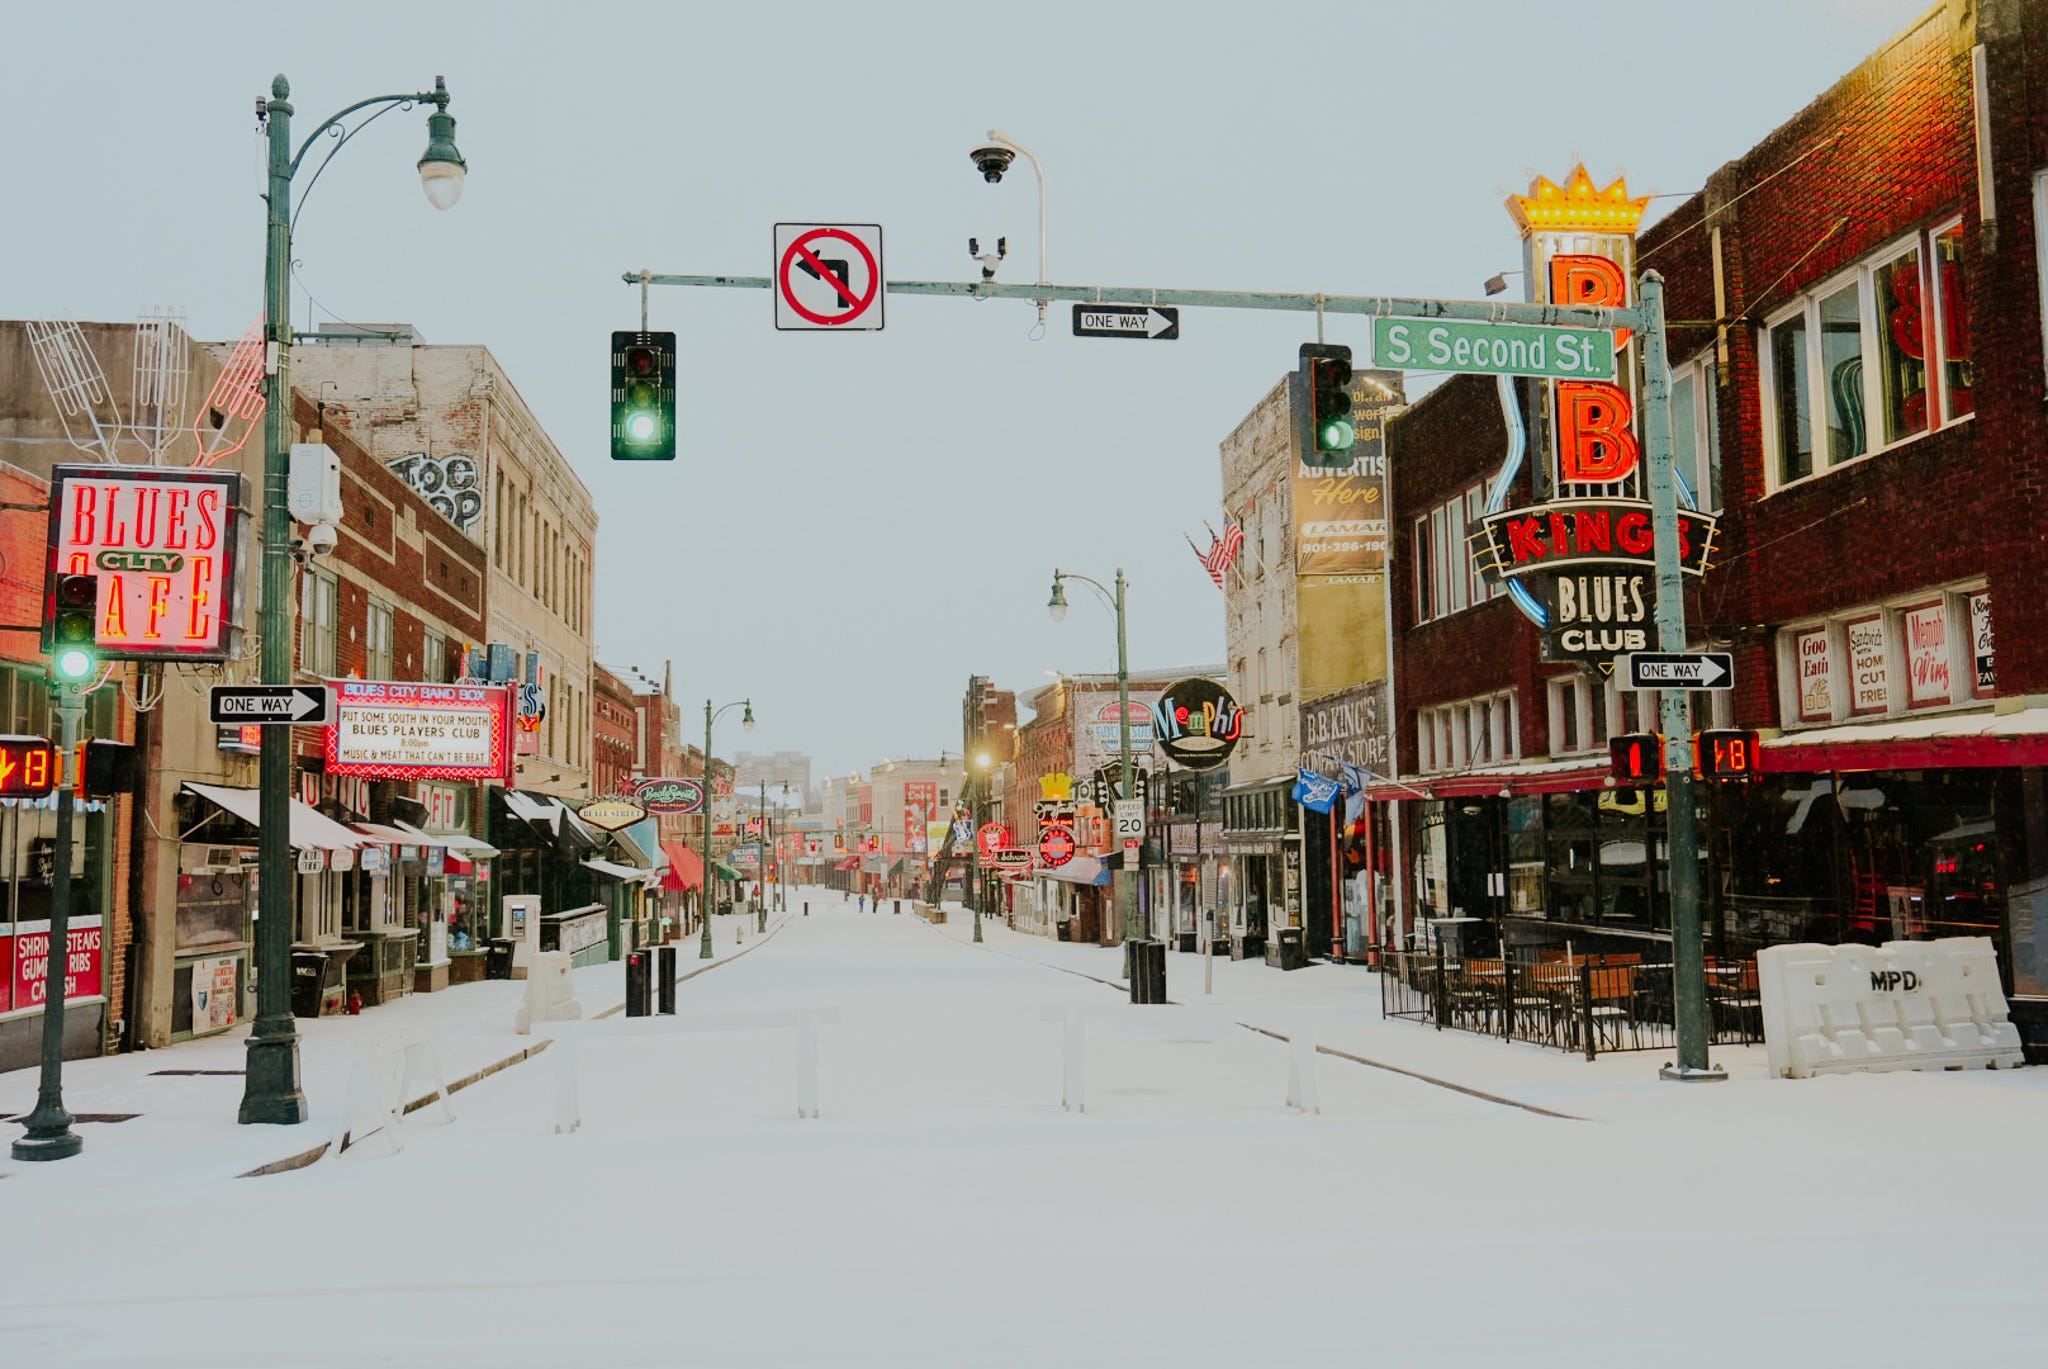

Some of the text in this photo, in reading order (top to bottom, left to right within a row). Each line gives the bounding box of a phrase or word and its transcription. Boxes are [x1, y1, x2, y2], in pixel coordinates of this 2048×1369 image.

[1085, 314, 1148, 329] ONE WAY
[1387, 325, 1602, 374] S. Second St.
[1558, 380, 1640, 485] B
[1311, 474, 1380, 505] Here
[68, 485, 218, 550] BLUES
[101, 552, 182, 571] CITY
[1328, 575, 1377, 584] LAMAR
[68, 552, 213, 640] AFE
[1558, 575, 1646, 624] BLUES
[1560, 629, 1647, 652] CLUB
[1641, 664, 1700, 678] ONE WAY
[1860, 670, 1886, 685] CUT
[344, 683, 486, 700] BLUES CITY BAND BOX
[223, 698, 293, 712] ONE WAY
[342, 711, 489, 726] PUT SOME SOUTH IN YOUR MOUTH
[1152, 695, 1245, 741] Memphis
[352, 724, 480, 739] BLUES PLAYERS CLUB
[343, 749, 485, 763] MUSIC & MEAT THAT CAN'T BE BEAT
[1347, 734, 1388, 767] STORE
[25, 750, 47, 787] 13
[1118, 803, 1142, 811] SPEED
[1119, 819, 1142, 832] 20
[66, 931, 101, 953] STEAKS
[69, 952, 91, 974] RIBS
[1870, 970, 1917, 992] MPD
